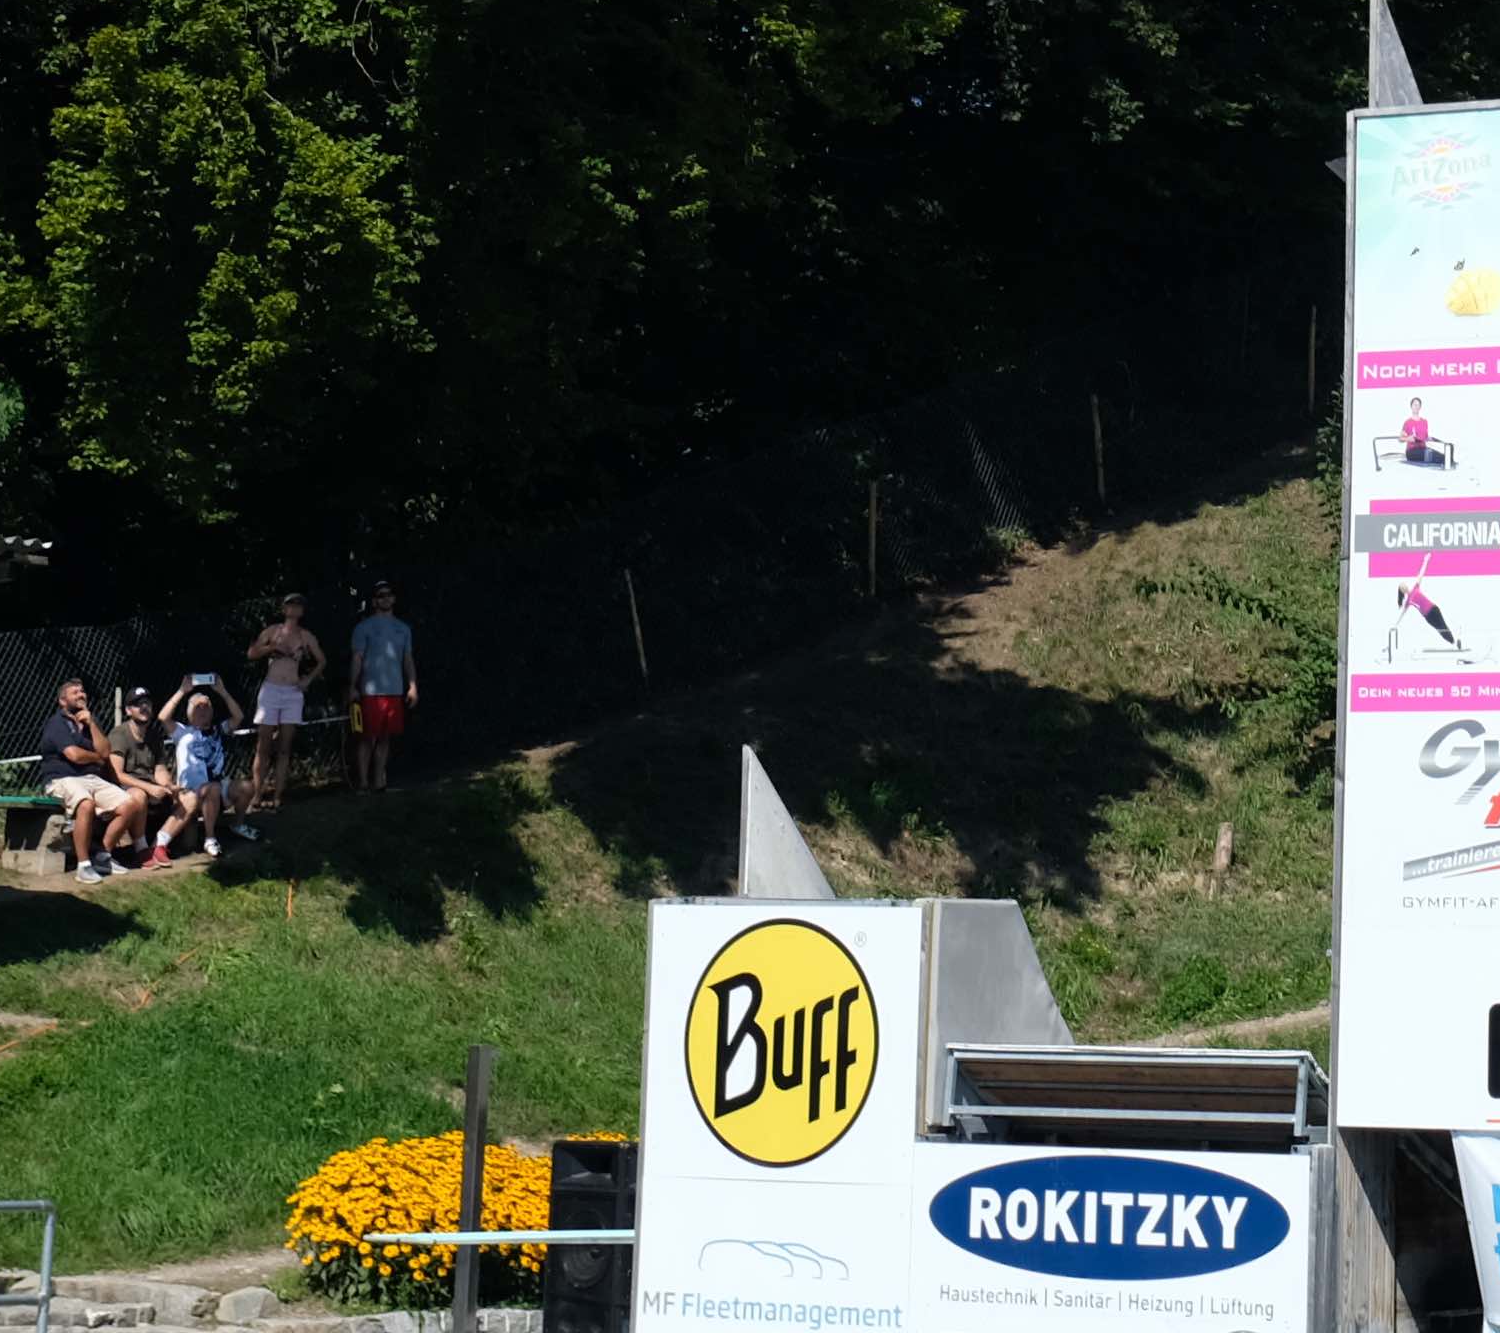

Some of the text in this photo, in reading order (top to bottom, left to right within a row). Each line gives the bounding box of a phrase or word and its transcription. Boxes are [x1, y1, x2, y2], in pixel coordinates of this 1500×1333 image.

[968, 1185, 1249, 1251] ROKITZKY
[642, 1290, 903, 1330] MF Fleetmanagement
[939, 1285, 1275, 1321] Haustechnik Sanitär Heizung Lüftung
